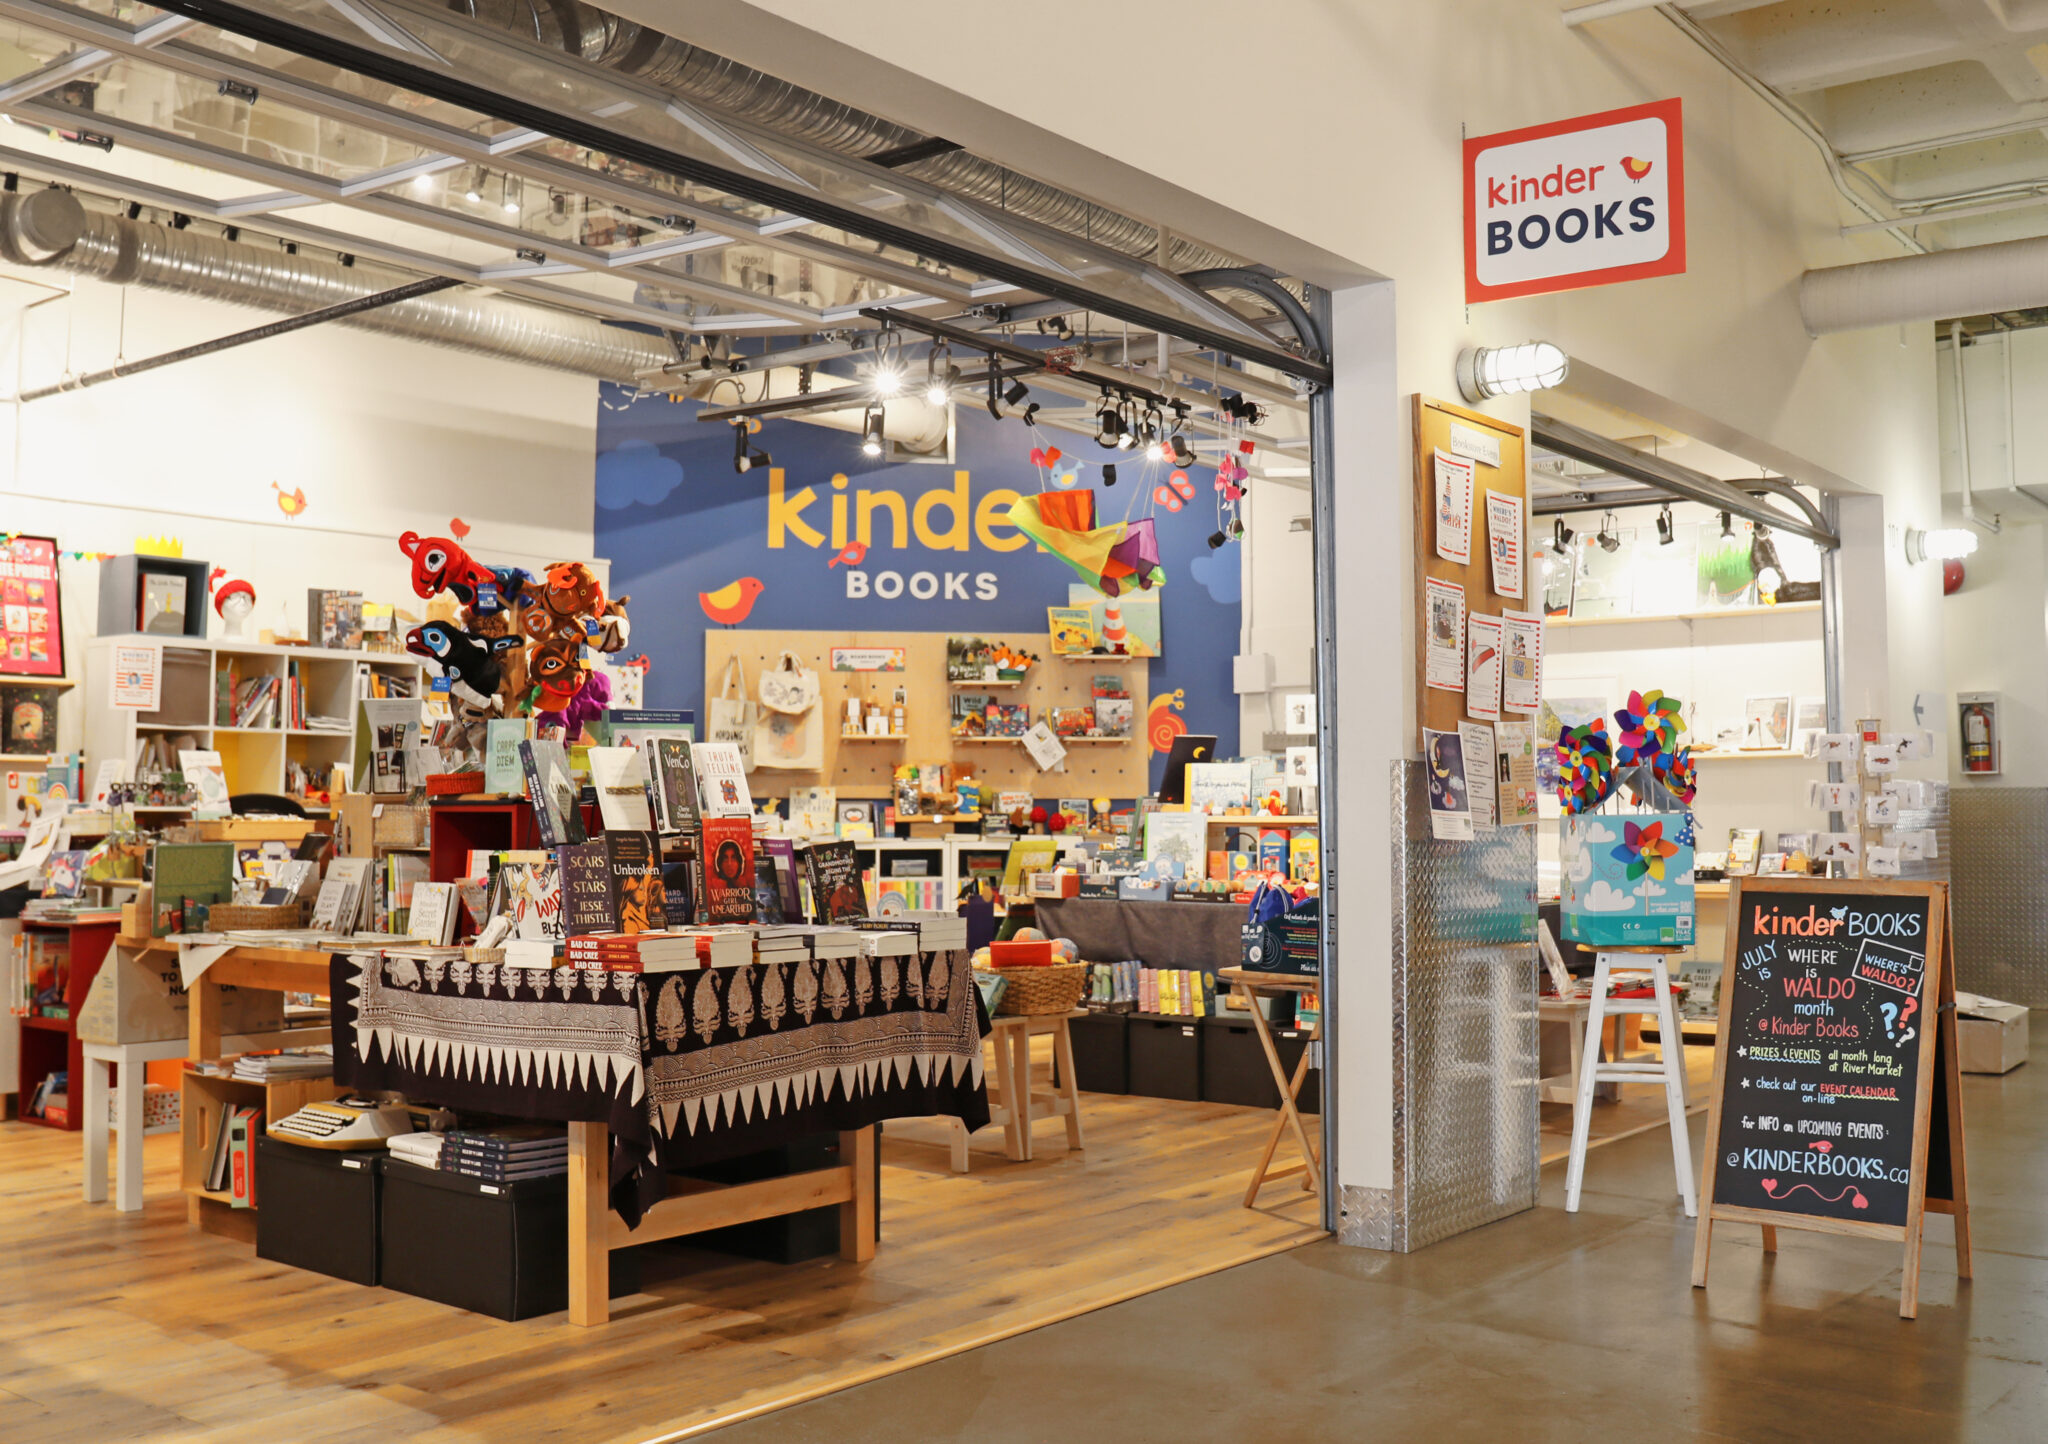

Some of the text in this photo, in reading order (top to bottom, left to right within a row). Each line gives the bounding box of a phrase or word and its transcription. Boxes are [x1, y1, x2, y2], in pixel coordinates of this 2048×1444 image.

[1488, 164, 1605, 208] kinder
[1487, 196, 1656, 256] BOOKS
[767, 467, 1049, 553] kinde
[1493, 506, 1512, 517] WHERE'S
[846, 571, 998, 600] BOOKS
[496, 740, 515, 752] CARPE
[496, 755, 515, 767] DIEM
[665, 754, 690, 769] VenCo
[707, 751, 734, 761] TRUTH
[706, 763, 740, 774] TELLING
[570, 856, 605, 868] SCARS
[818, 858, 854, 869] GRANDMOTHER
[585, 870, 593, 879] &
[613, 863, 660, 876] Unbroken
[573, 881, 606, 893] STARS
[711, 888, 753, 902] WARRIOR
[580, 900, 605, 911] JESSE
[711, 904, 753, 916] UNEARTHED
[573, 913, 612, 924] THISTLE
[1754, 905, 1920, 936] kinder BOOKS
[570, 941, 583, 949] BAD
[584, 941, 598, 949] CREE
[570, 951, 583, 959] BAD
[584, 951, 599, 960] CREE
[1742, 939, 1778, 970] JULY
[1788, 949, 1838, 965] WHERE
[574, 961, 587, 969] BAD
[588, 962, 603, 970] CREE
[1865, 953, 1909, 974] WHERE'S
[160, 972, 178, 983] TO
[1861, 964, 1915, 992] WALDO?
[1784, 978, 1855, 999] WALDO
[1794, 1000, 1834, 1016] month
[1759, 1016, 1859, 1038] @ Kinder Books
[1750, 1046, 1780, 1059] PRIZES
[1789, 1048, 1821, 1061] EVENTS
[1828, 1049, 1838, 1061] all
[1841, 1050, 1868, 1062] month
[1873, 1051, 1892, 1066] long
[1829, 1062, 1903, 1078] at River Market
[1756, 1077, 1896, 1098] check out our EVENT CALENDAR
[1802, 1093, 1836, 1105] on-line
[1741, 1116, 1755, 1130] for
[1758, 1116, 1779, 1132] INFO
[1798, 1120, 1841, 1137] UPCOMING
[1727, 1147, 1909, 1185] @ KINDERBOOKS.ca
